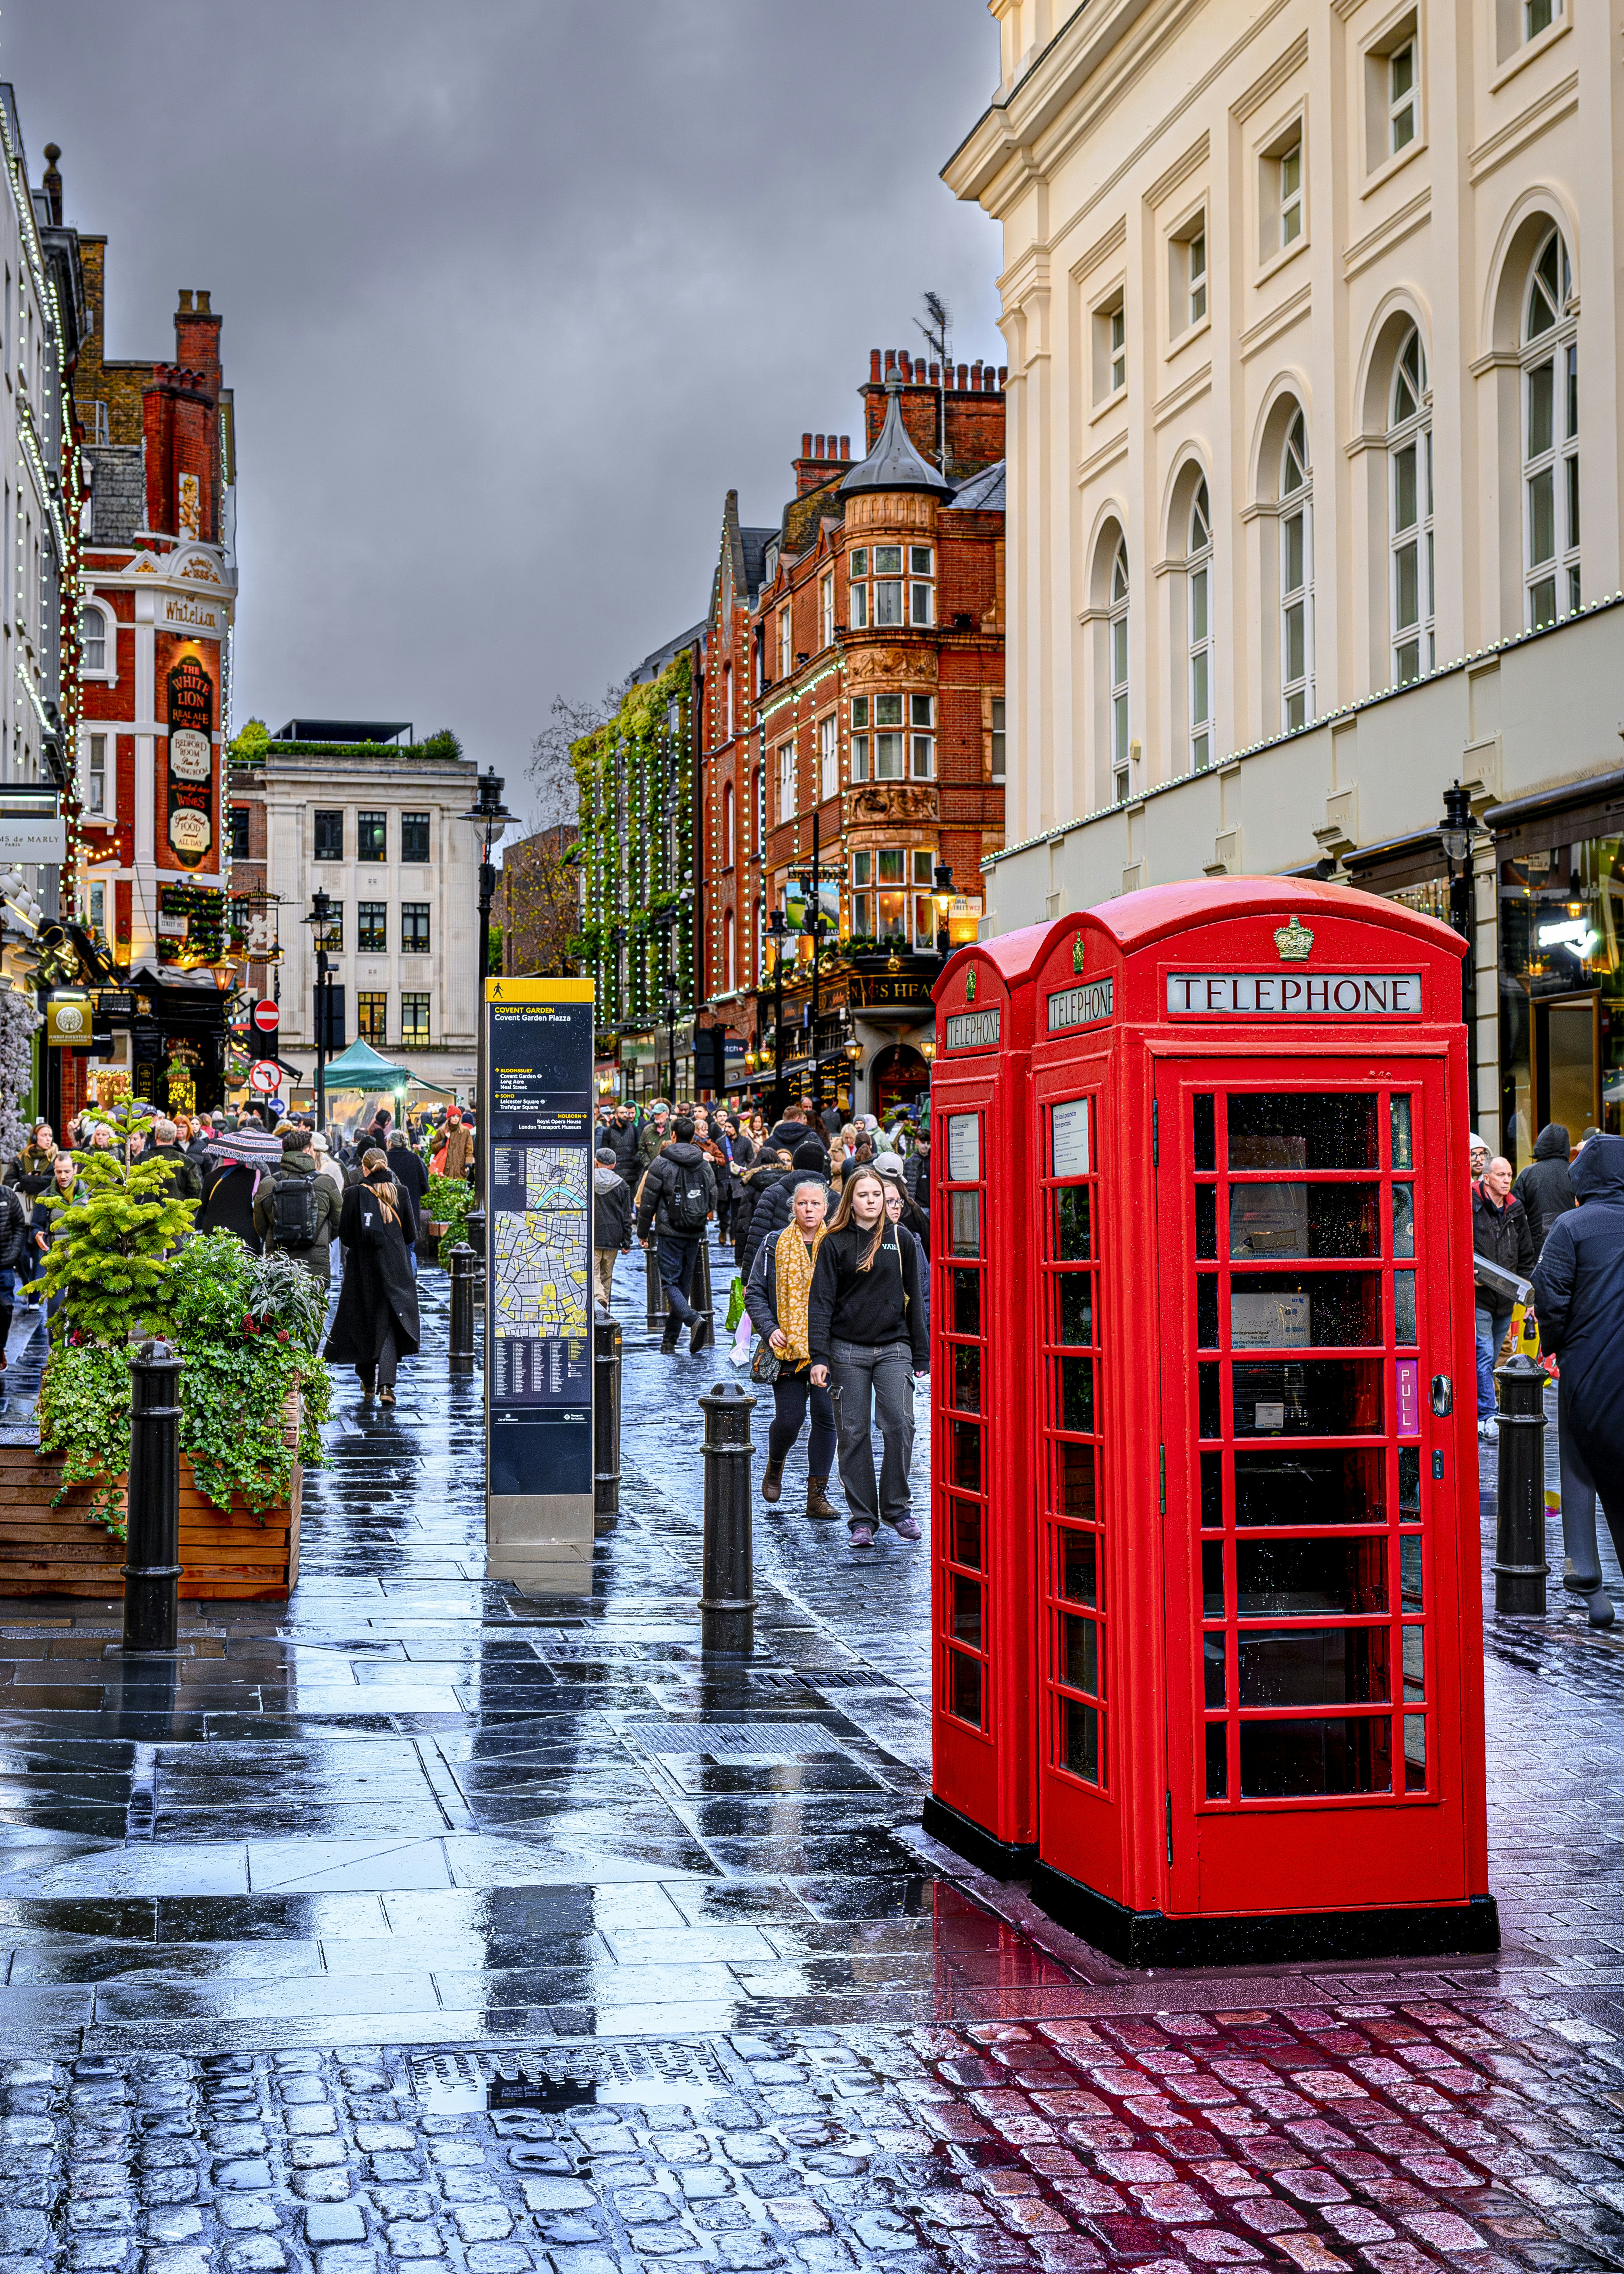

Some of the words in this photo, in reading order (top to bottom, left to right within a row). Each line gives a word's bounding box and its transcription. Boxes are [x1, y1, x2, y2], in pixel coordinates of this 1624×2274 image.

[166, 600, 195, 623] White
[195, 606, 215, 627] Lion
[182, 665, 200, 676] THE
[172, 676, 210, 696] WHITE
[178, 691, 205, 708] LION
[172, 709, 192, 721] REAL
[193, 713, 209, 724] ALE
[175, 738, 207, 751] BEDFORD
[180, 748, 200, 757] ROOM
[181, 821, 200, 832] FOOD
[894, 984, 934, 997] HEA
[1174, 979, 1411, 1011] TELEPHONE
[1051, 984, 1113, 1028] TELEPHONE
[949, 1013, 1000, 1046] TELEPHONE
[1402, 1370, 1411, 1425] PULL
